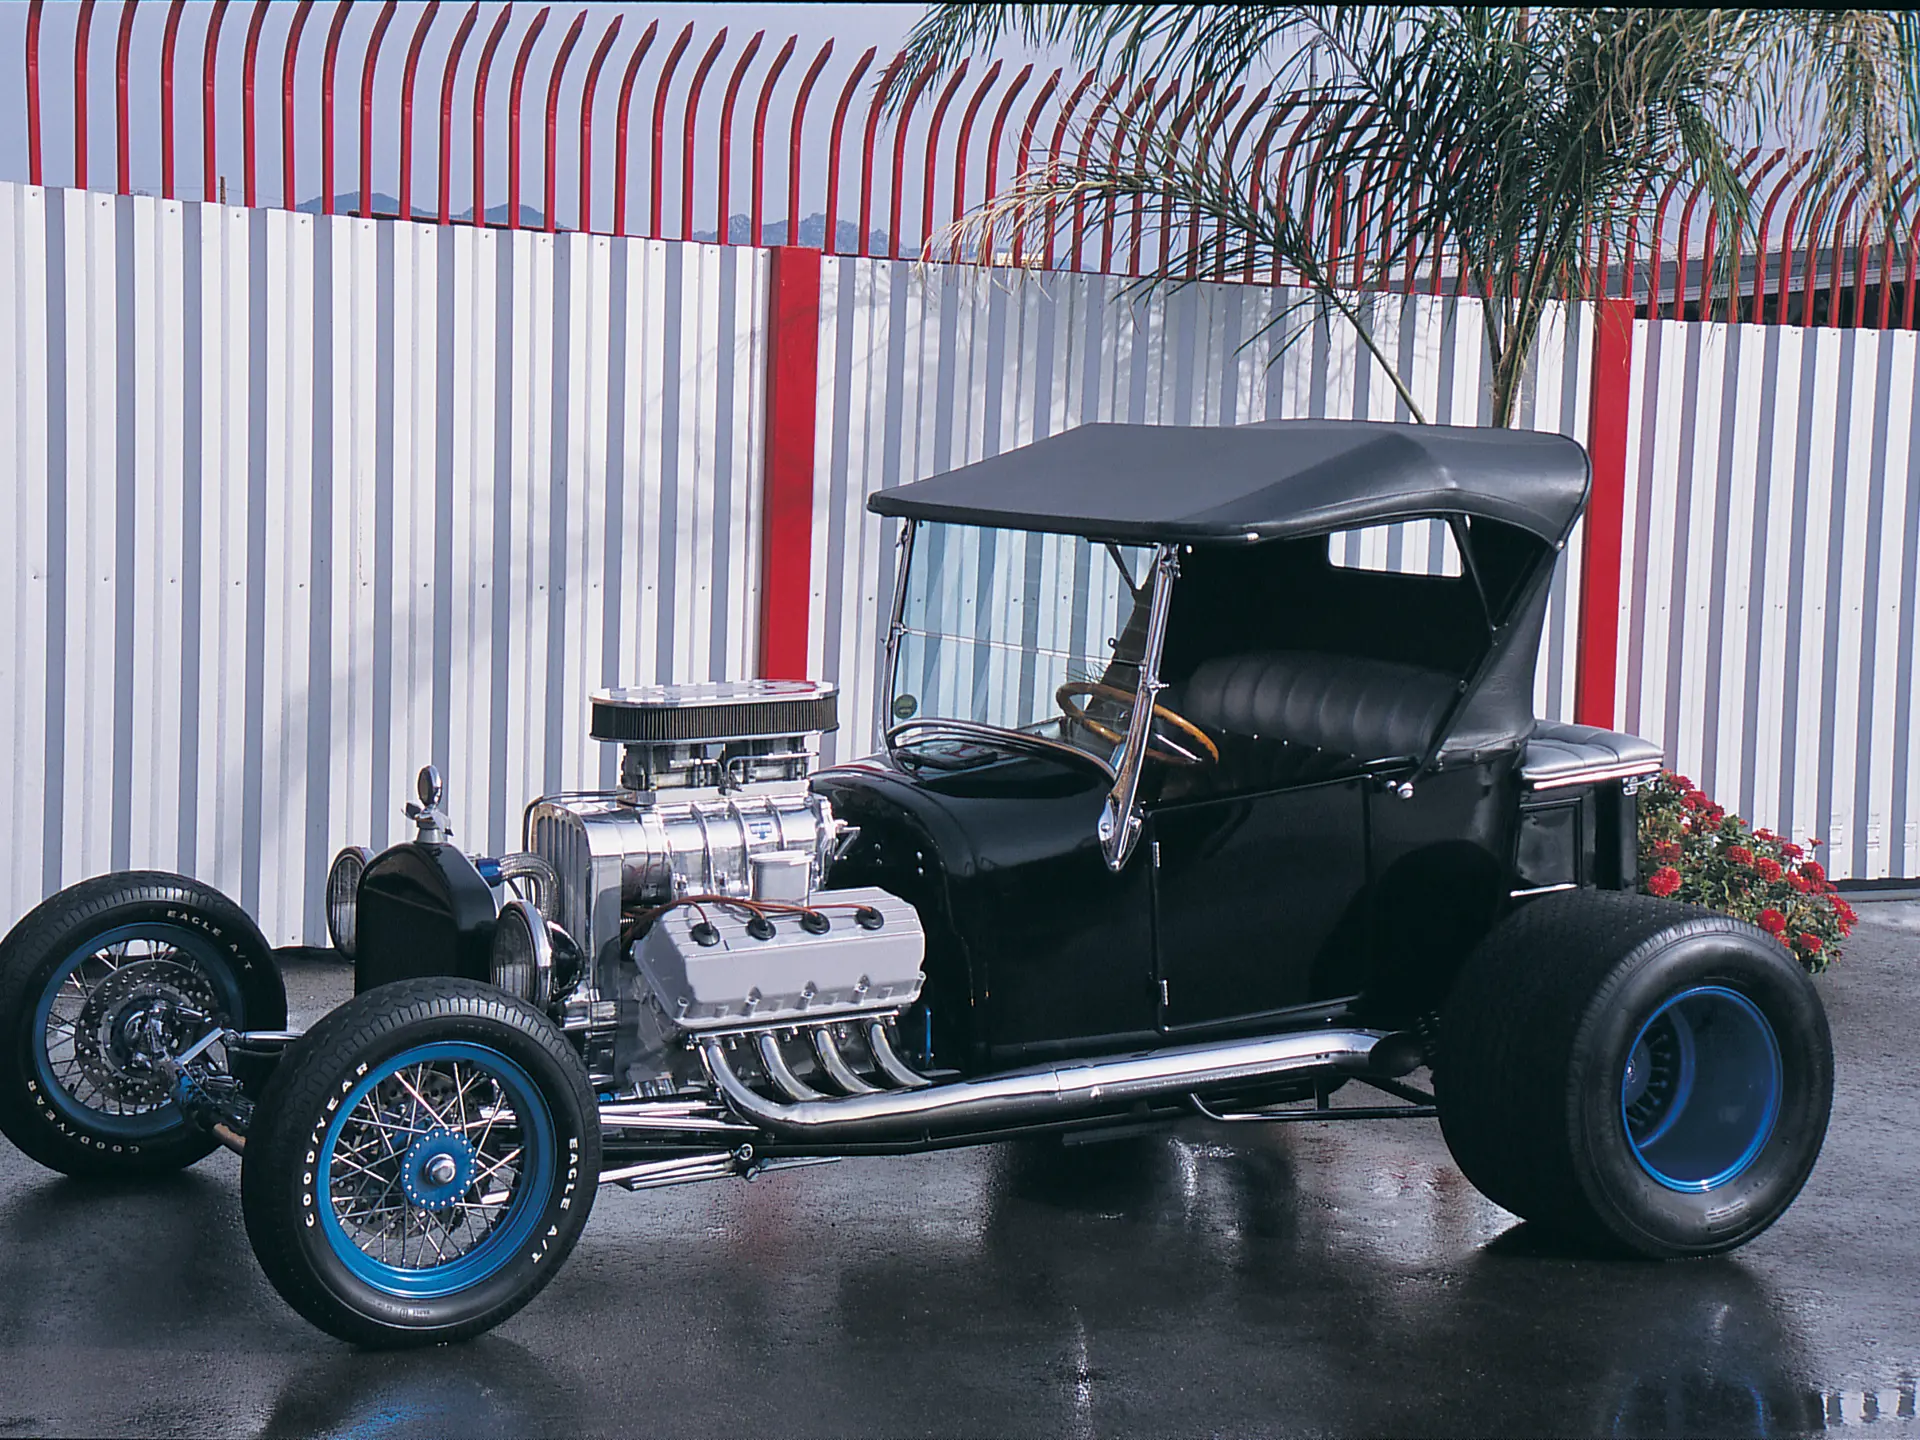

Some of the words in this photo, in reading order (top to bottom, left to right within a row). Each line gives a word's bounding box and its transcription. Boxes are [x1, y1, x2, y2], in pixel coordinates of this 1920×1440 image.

[167, 909, 222, 936] EAGLE
[28, 1080, 139, 1153] GOODYEAR
[303, 1062, 368, 1227] GOODYEAR
[560, 1137, 578, 1210] EAGLE
